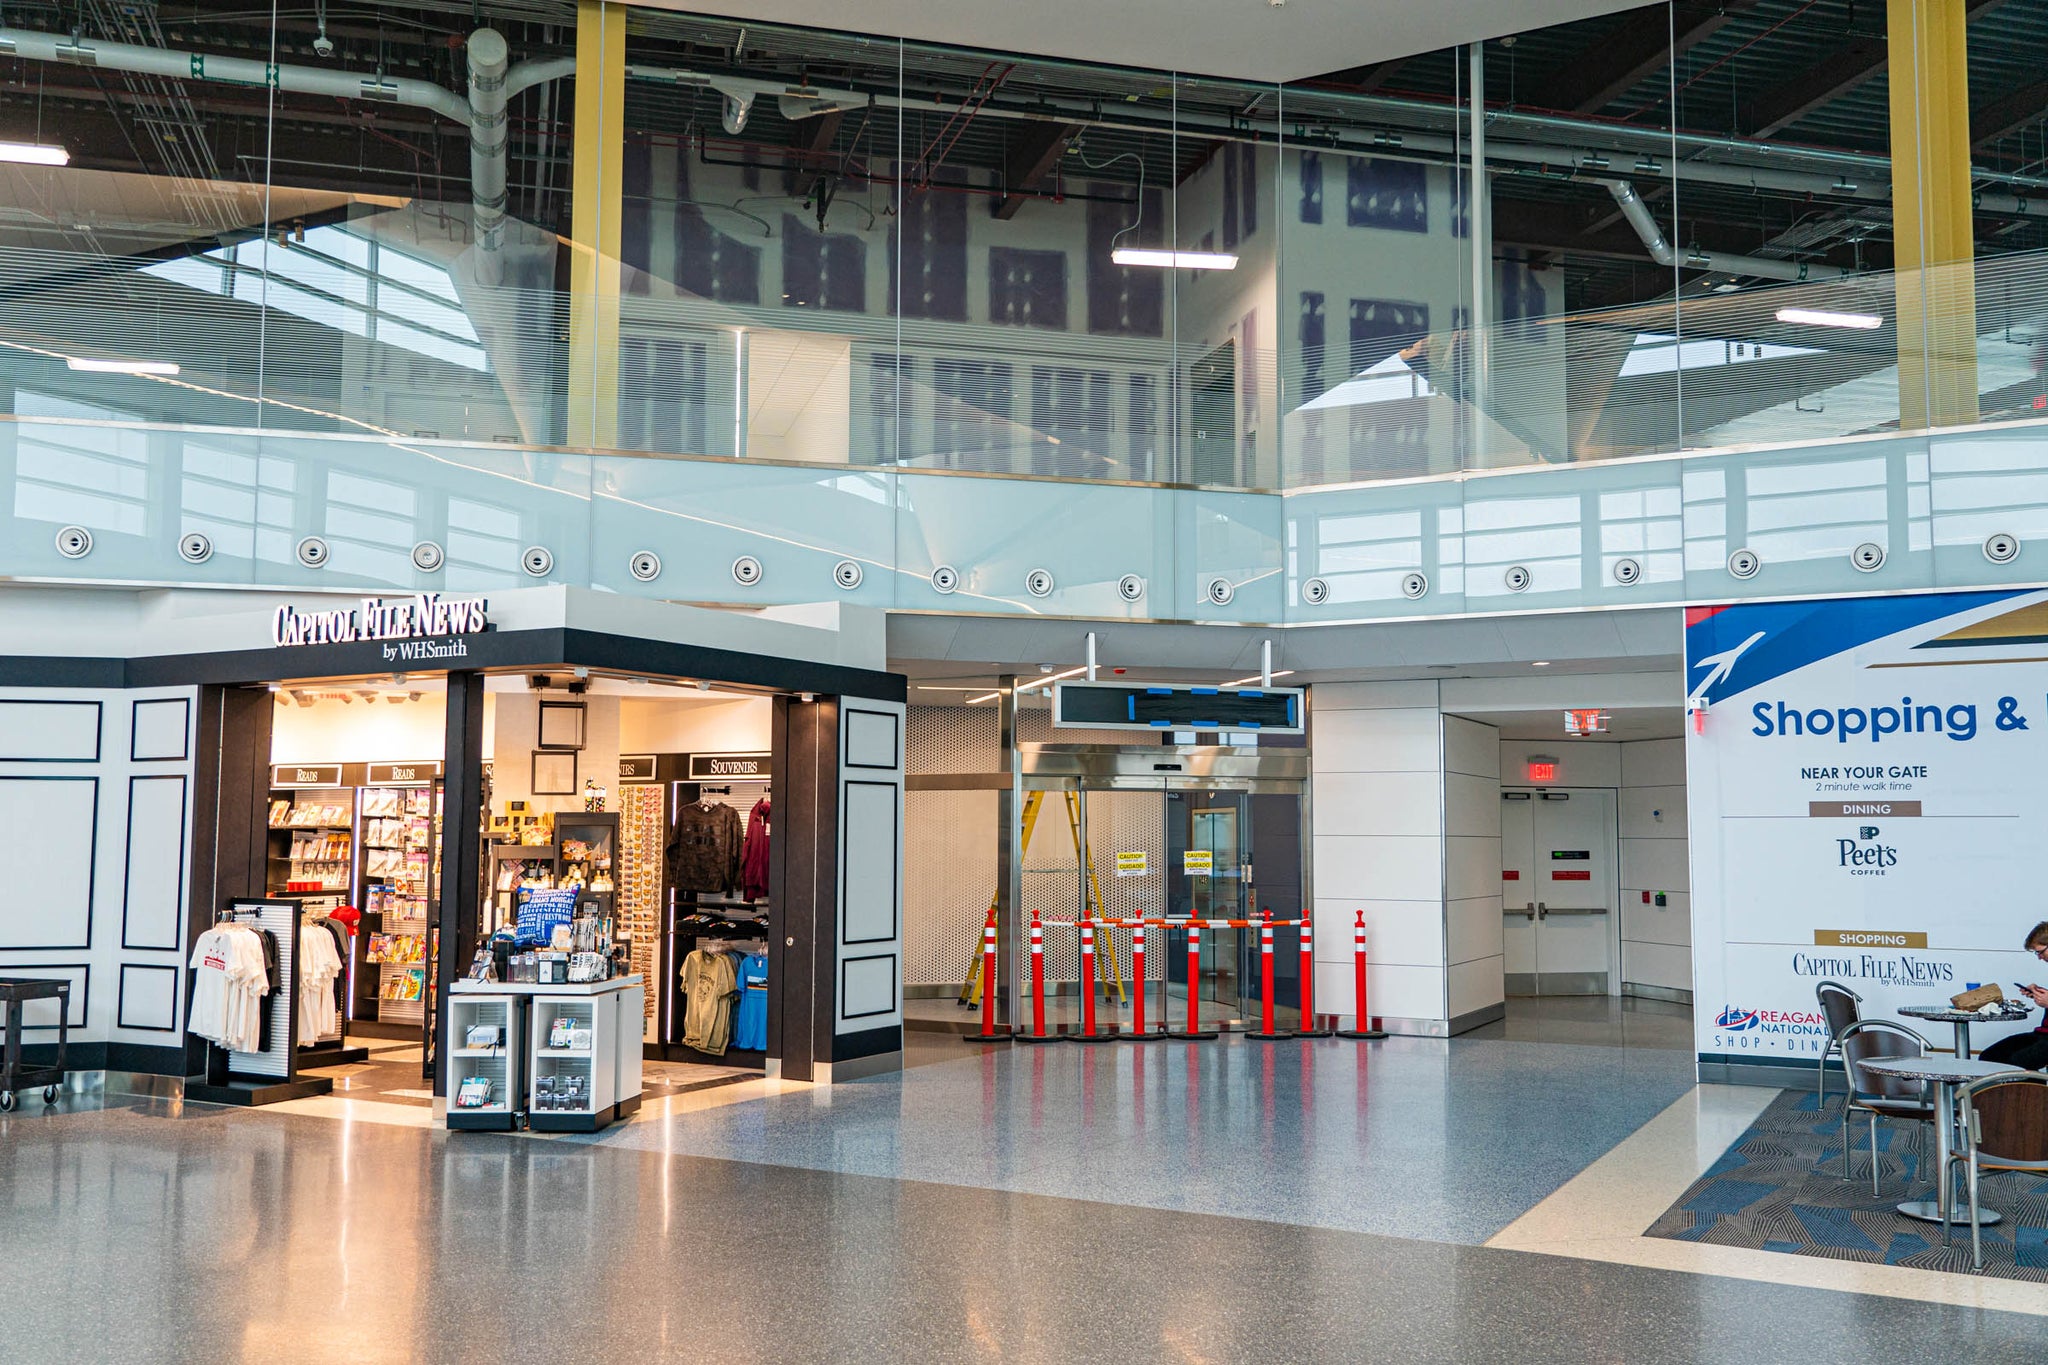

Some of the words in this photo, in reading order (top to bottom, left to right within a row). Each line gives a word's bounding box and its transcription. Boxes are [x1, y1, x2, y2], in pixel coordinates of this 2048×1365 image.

[272, 604, 357, 647] CAPITOL
[358, 598, 414, 641] FILE
[413, 592, 488, 637] NEWS
[382, 643, 398, 661] by
[399, 638, 468, 660] WHSmith
[1751, 696, 1978, 743] Shopping
[1995, 696, 2030, 731] &
[391, 766, 416, 780] READS
[710, 758, 758, 774] SOUVENIRS
[1535, 764, 1554, 779] EXIT
[1801, 767, 1839, 779] NEAR
[1844, 766, 1884, 779] YOUR
[1888, 765, 1928, 778] GATE
[296, 769, 318, 782] READS
[1815, 782, 1822, 792] 2
[1824, 781, 1860, 791] minute
[1863, 781, 1887, 791] walk
[1889, 781, 1912, 791] time
[1842, 804, 1892, 815] DINING
[1836, 839, 1897, 868] Peet's
[1839, 933, 1907, 946] SHOPPING
[1793, 952, 1857, 977] CAPITOL
[1860, 955, 1896, 979] FILE
[1900, 956, 1954, 982] NEWS
[1880, 976, 1892, 987] by
[1893, 977, 1936, 988] WHSmith
[1715, 1035, 1760, 1049] SHOP
[1788, 1038, 1828, 1052] DIN
